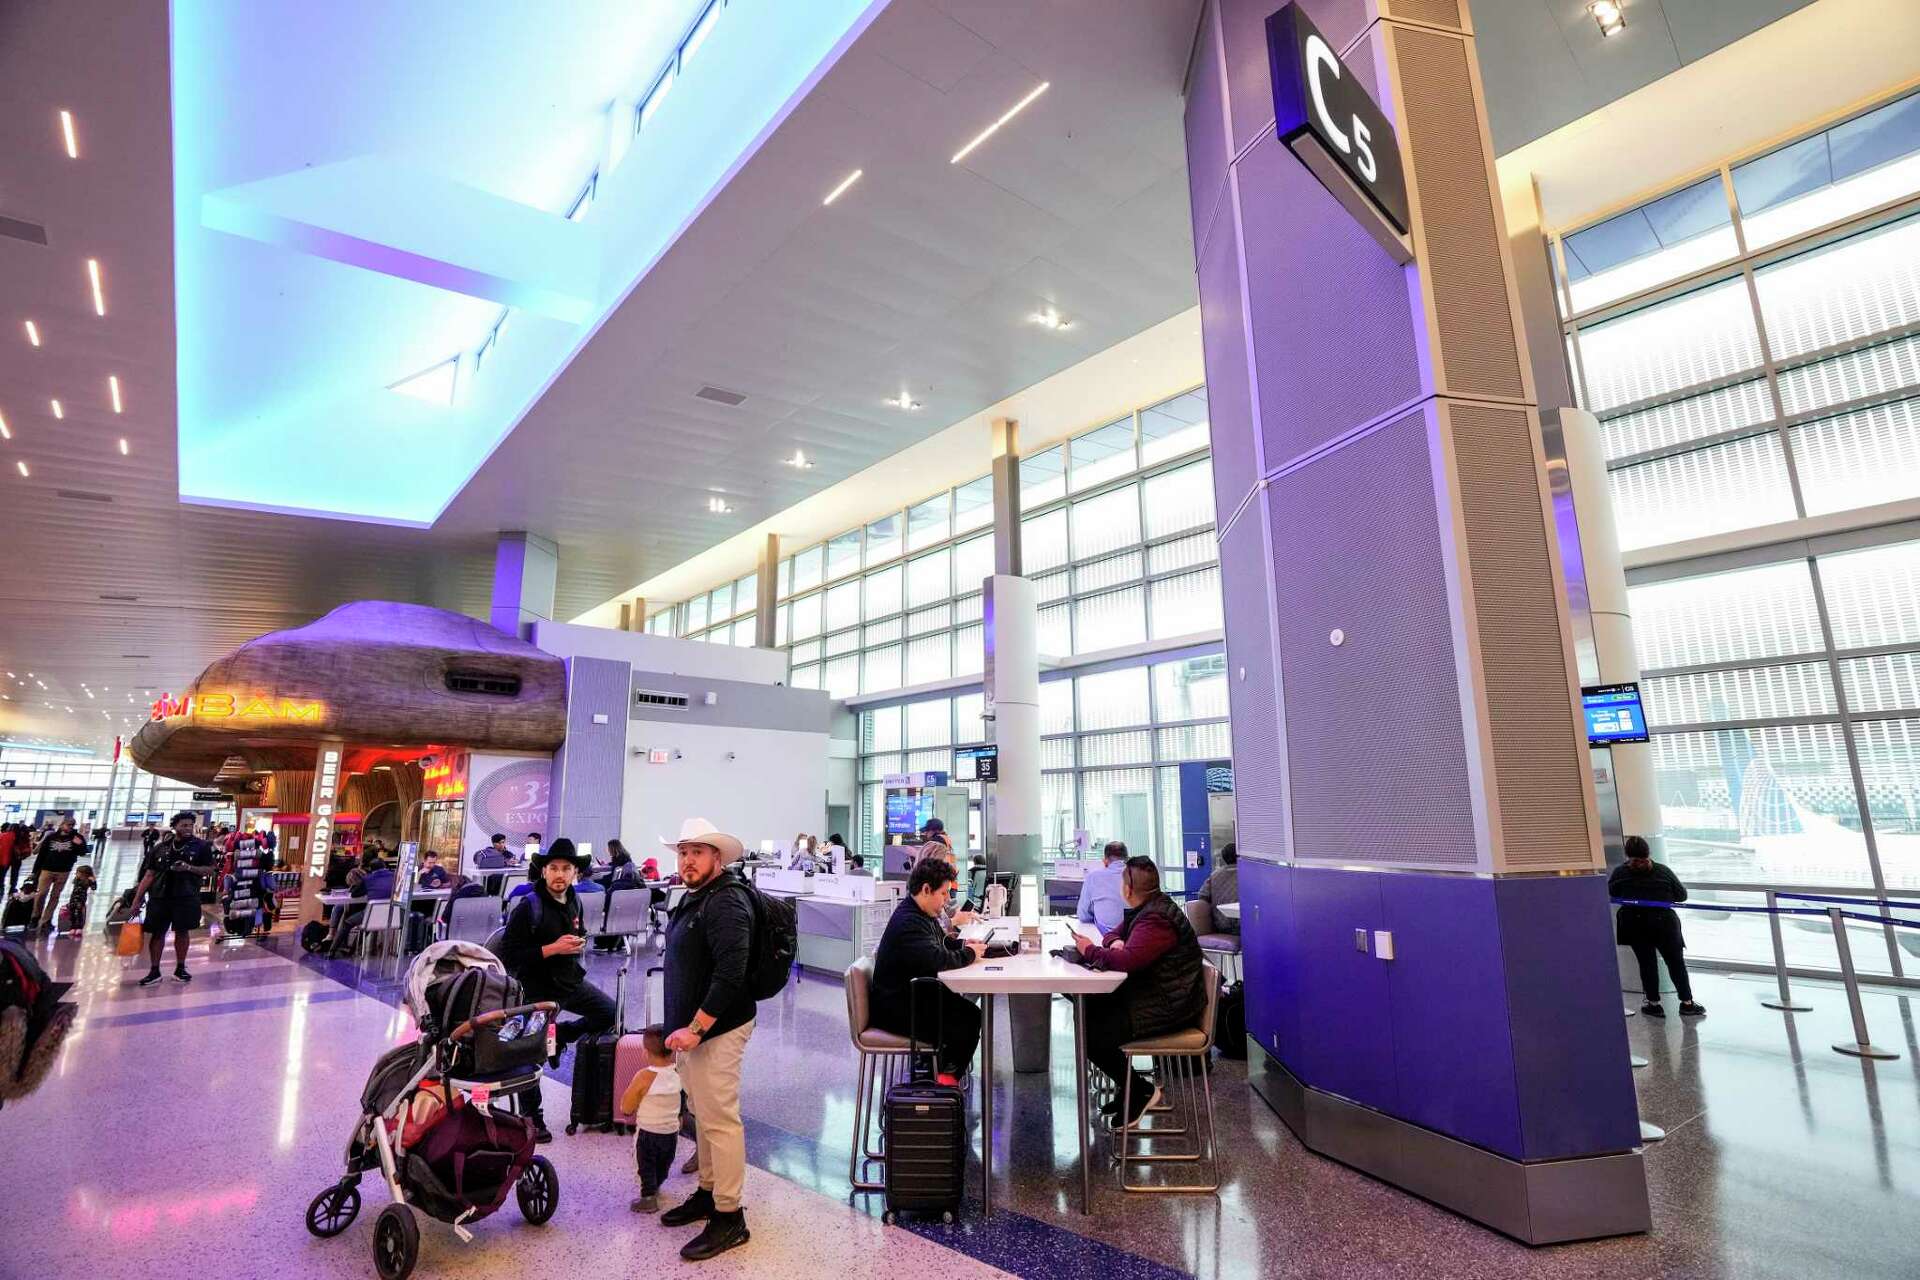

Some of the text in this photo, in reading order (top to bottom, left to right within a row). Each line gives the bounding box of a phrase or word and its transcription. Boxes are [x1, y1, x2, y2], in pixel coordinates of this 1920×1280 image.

[981, 762, 991, 772] 35
[309, 751, 338, 877] BEER GARDEN
